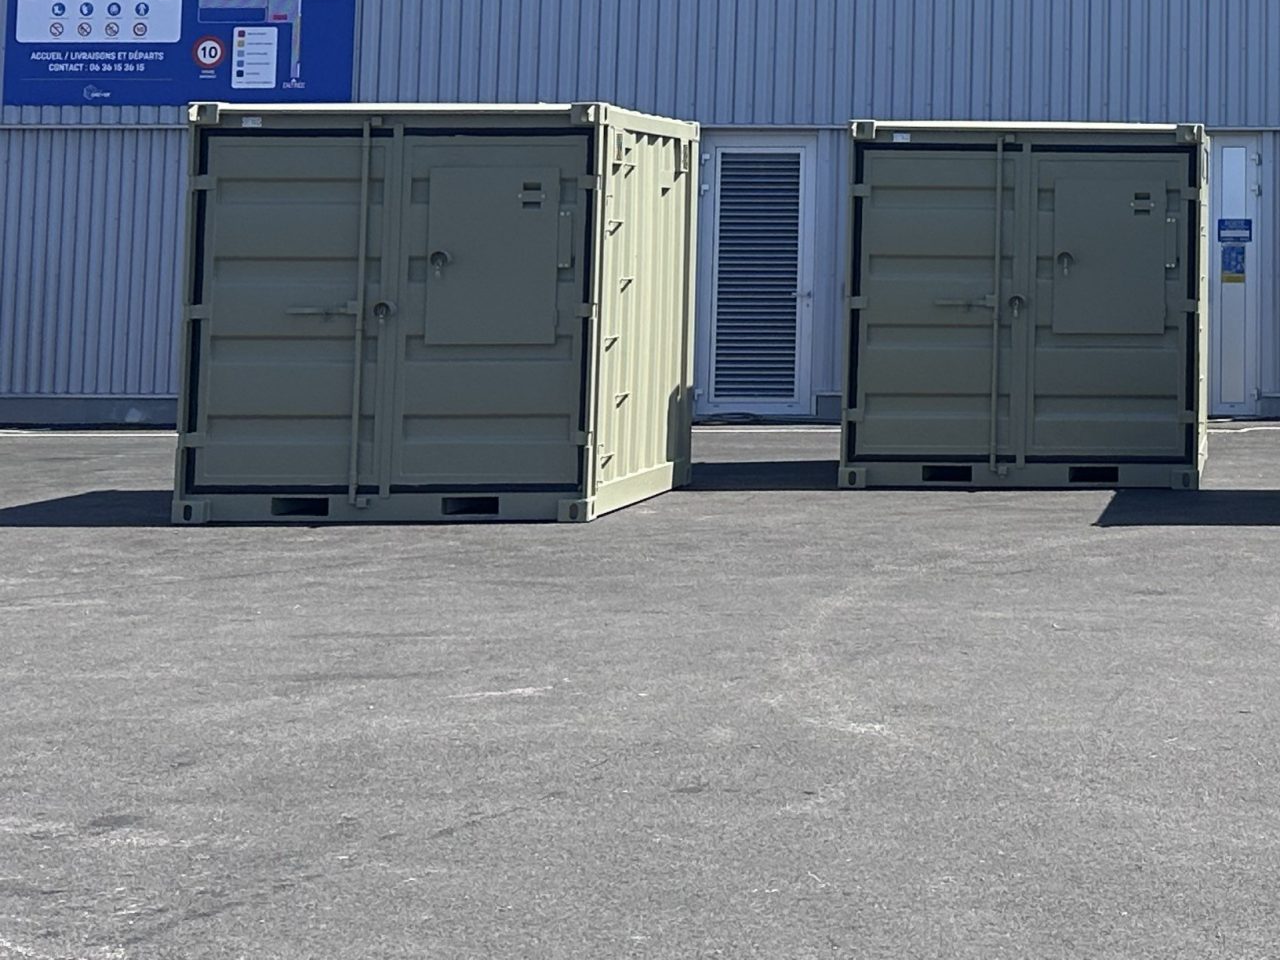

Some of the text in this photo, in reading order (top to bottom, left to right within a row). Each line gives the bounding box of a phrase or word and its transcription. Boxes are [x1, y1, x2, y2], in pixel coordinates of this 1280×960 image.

[30, 52, 63, 60] ACCUEIL
[70, 52, 116, 60] LIVRAISONS
[117, 52, 127, 60] ET
[128, 50, 164, 60] DÉPARTS
[201, 46, 218, 58] 10
[48, 63, 84, 71] CONTACT
[89, 63, 101, 71] 06
[114, 63, 123, 71] 15
[136, 63, 145, 71] 15
